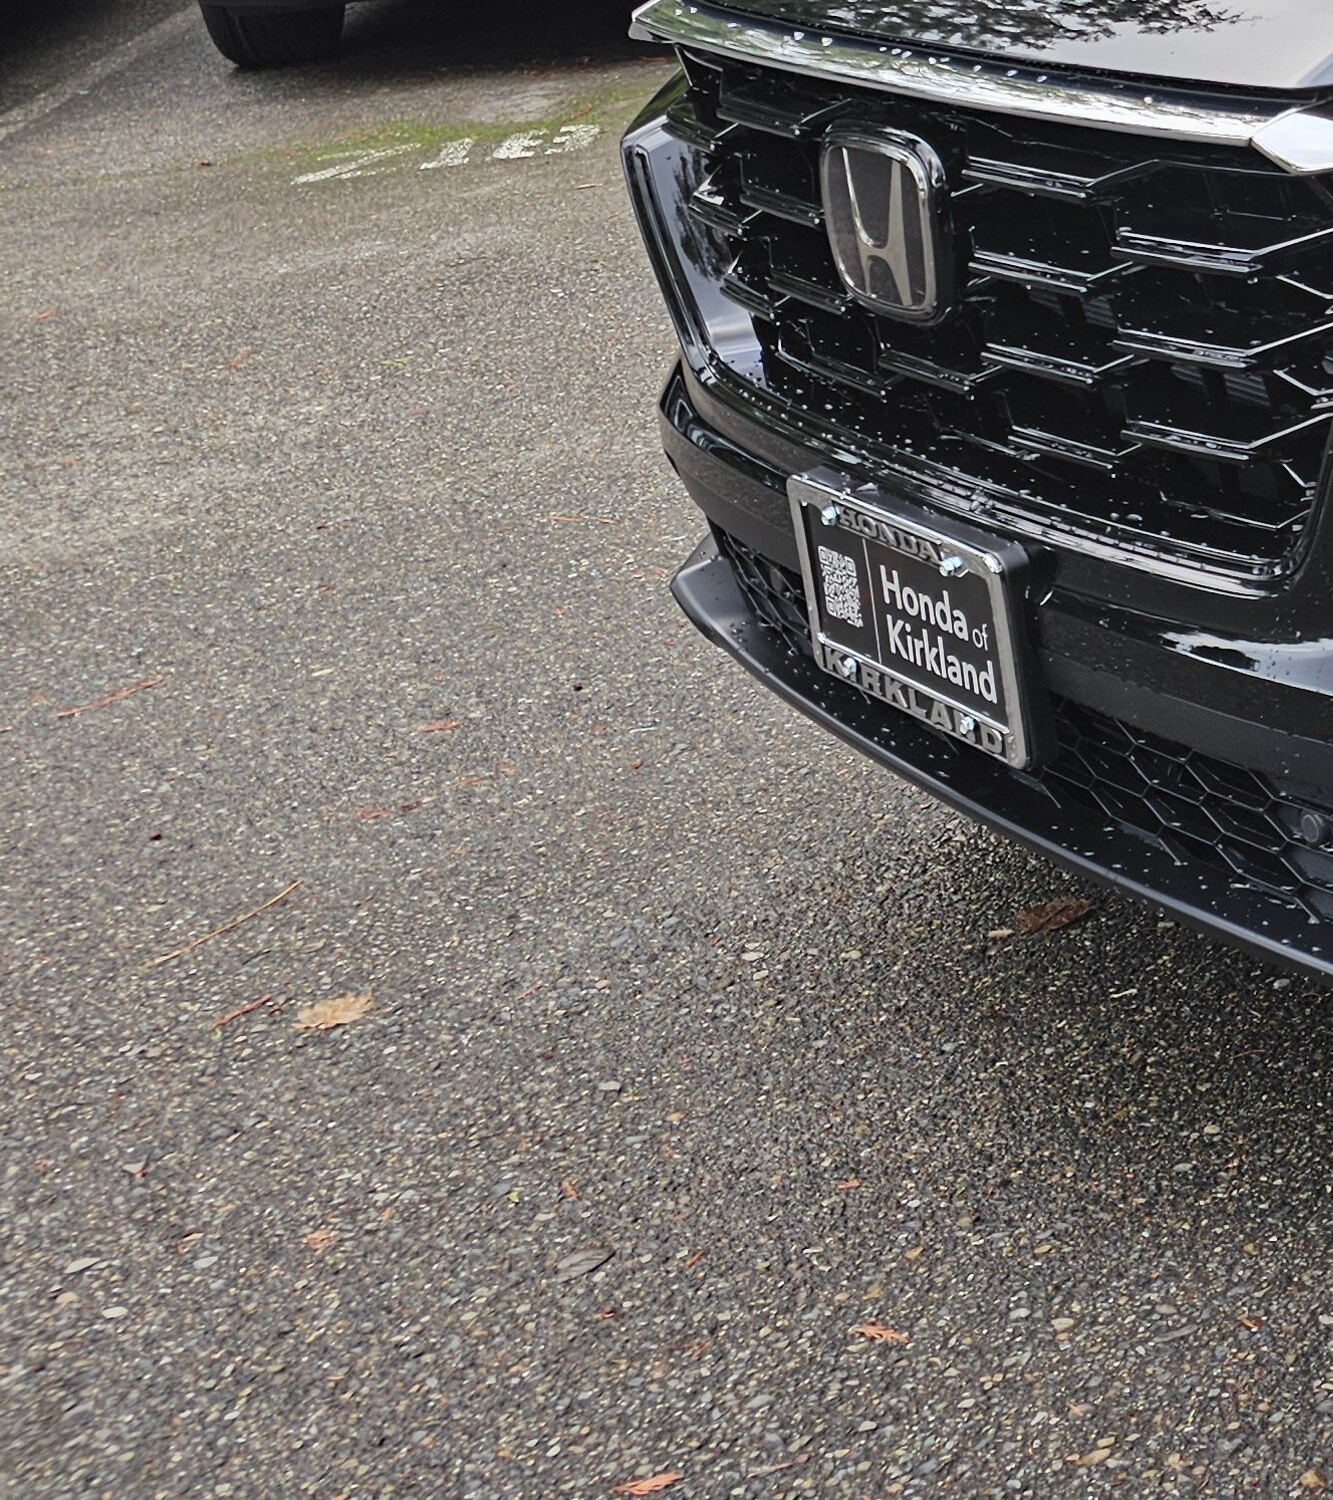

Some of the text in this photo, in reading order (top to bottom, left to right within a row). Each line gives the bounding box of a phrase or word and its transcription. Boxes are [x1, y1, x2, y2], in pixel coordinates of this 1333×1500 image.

[838, 505, 944, 564] HONDA
[879, 564, 989, 652] Honda of
[885, 613, 998, 705] Kirkland
